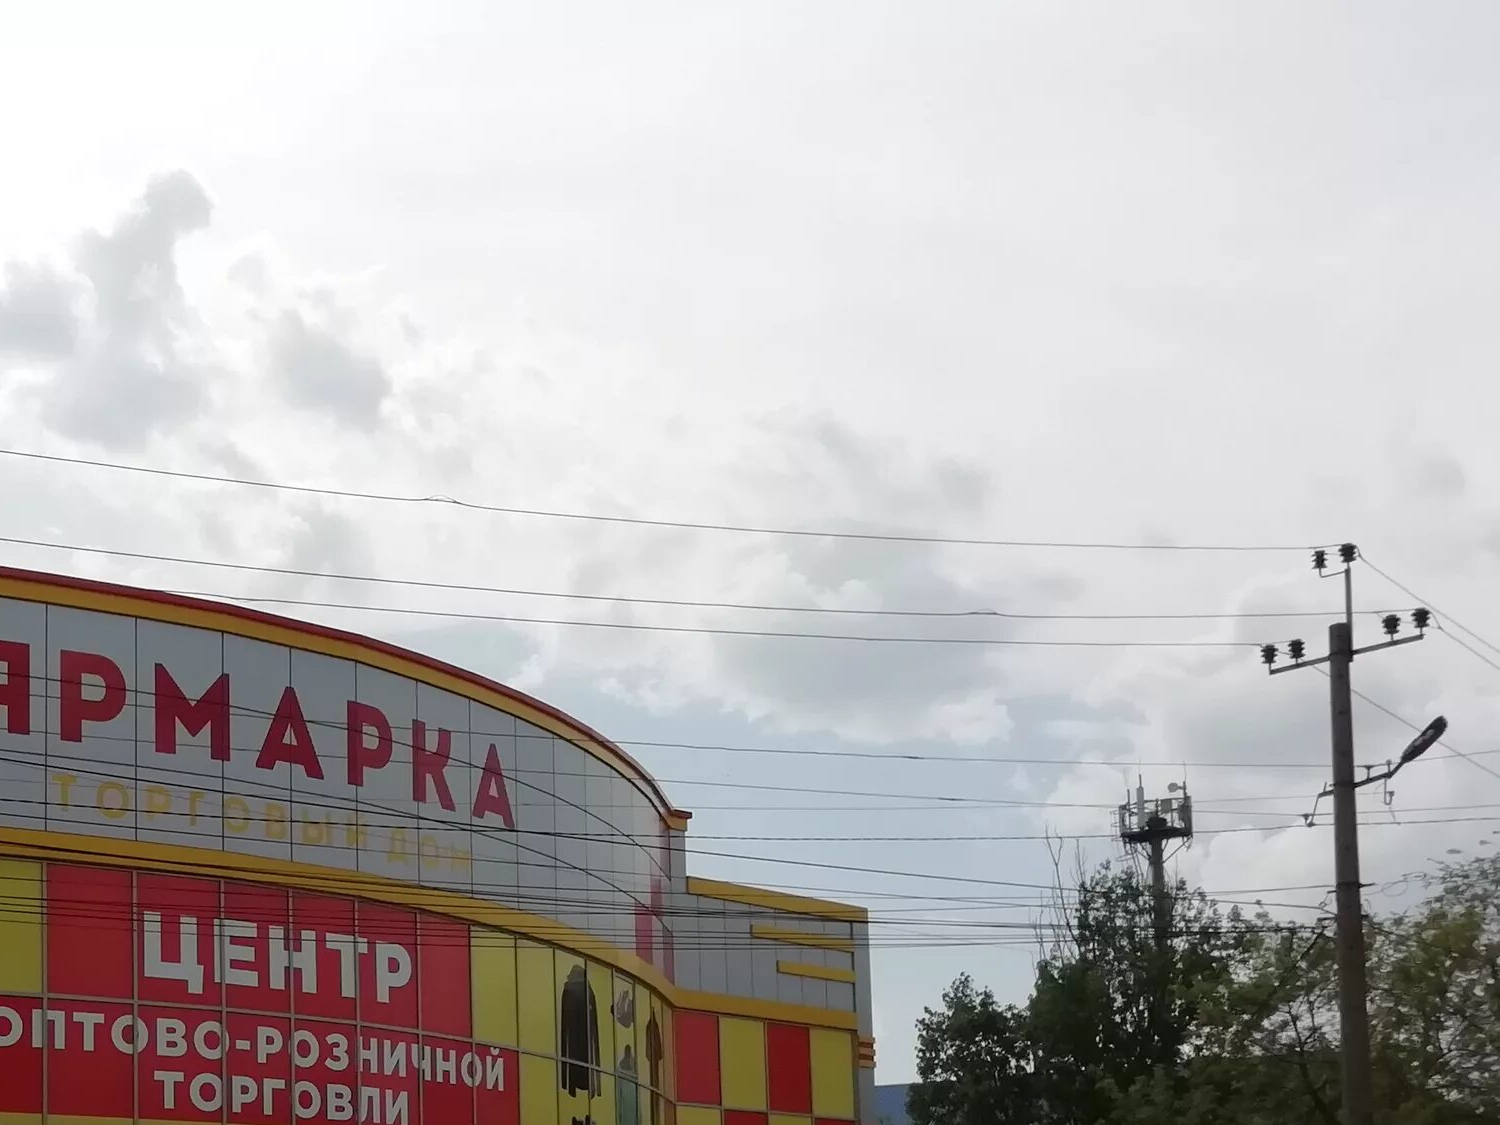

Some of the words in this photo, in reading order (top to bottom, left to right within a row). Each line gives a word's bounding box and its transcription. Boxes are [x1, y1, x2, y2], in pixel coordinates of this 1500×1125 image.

[51, 773, 369, 849] ТОРГОВЫЙ
[386, 828, 473, 874] ДОМ
[143, 910, 413, 1004] ЦЕНТР
